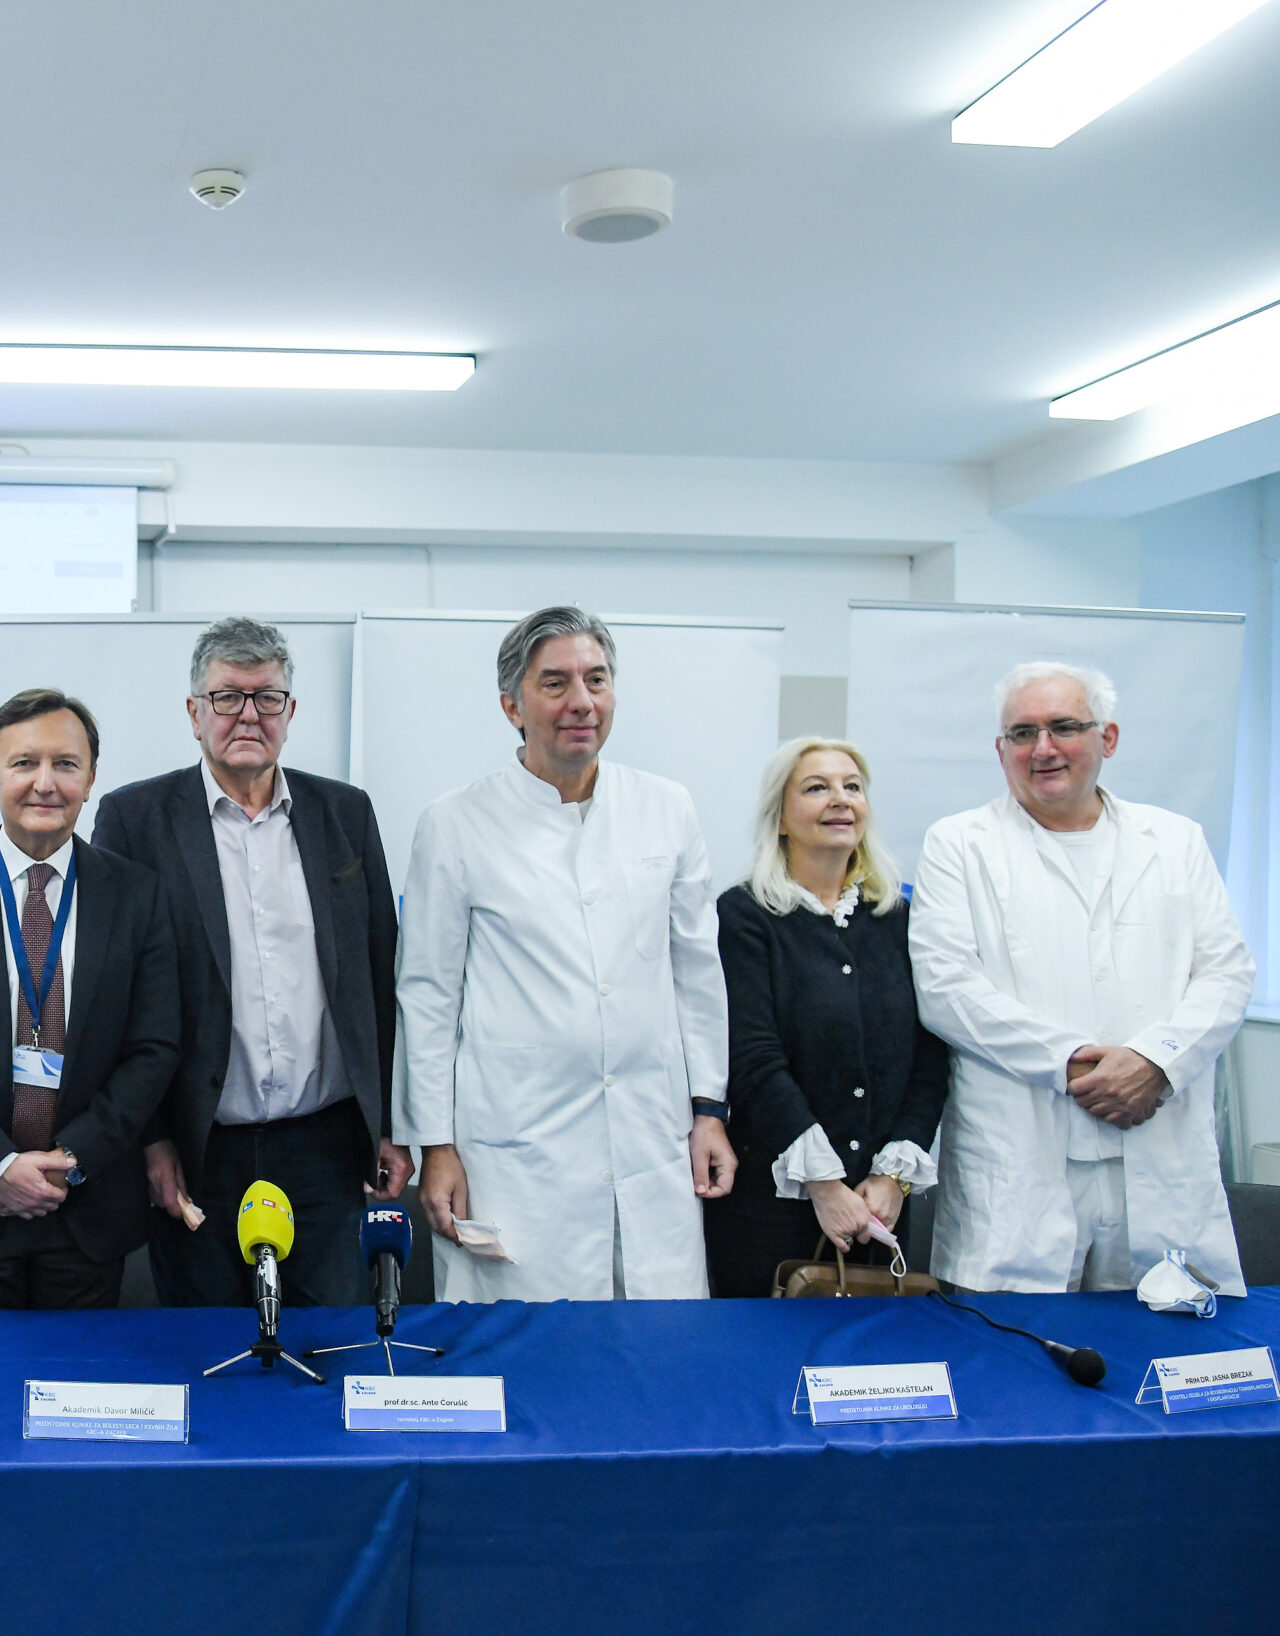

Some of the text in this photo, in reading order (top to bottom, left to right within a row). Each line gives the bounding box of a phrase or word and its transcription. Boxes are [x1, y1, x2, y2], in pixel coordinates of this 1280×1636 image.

[368, 1210, 403, 1223] HRT
[1212, 1373, 1230, 1382] JASNA
[1231, 1371, 1253, 1379] BREZAK
[830, 1385, 934, 1397] AKADEMIK ŽELJKO KAŠTELAN
[63, 1405, 155, 1415] Akademik Davor Miličić
[166, 1423, 179, 1431] ŽILA
